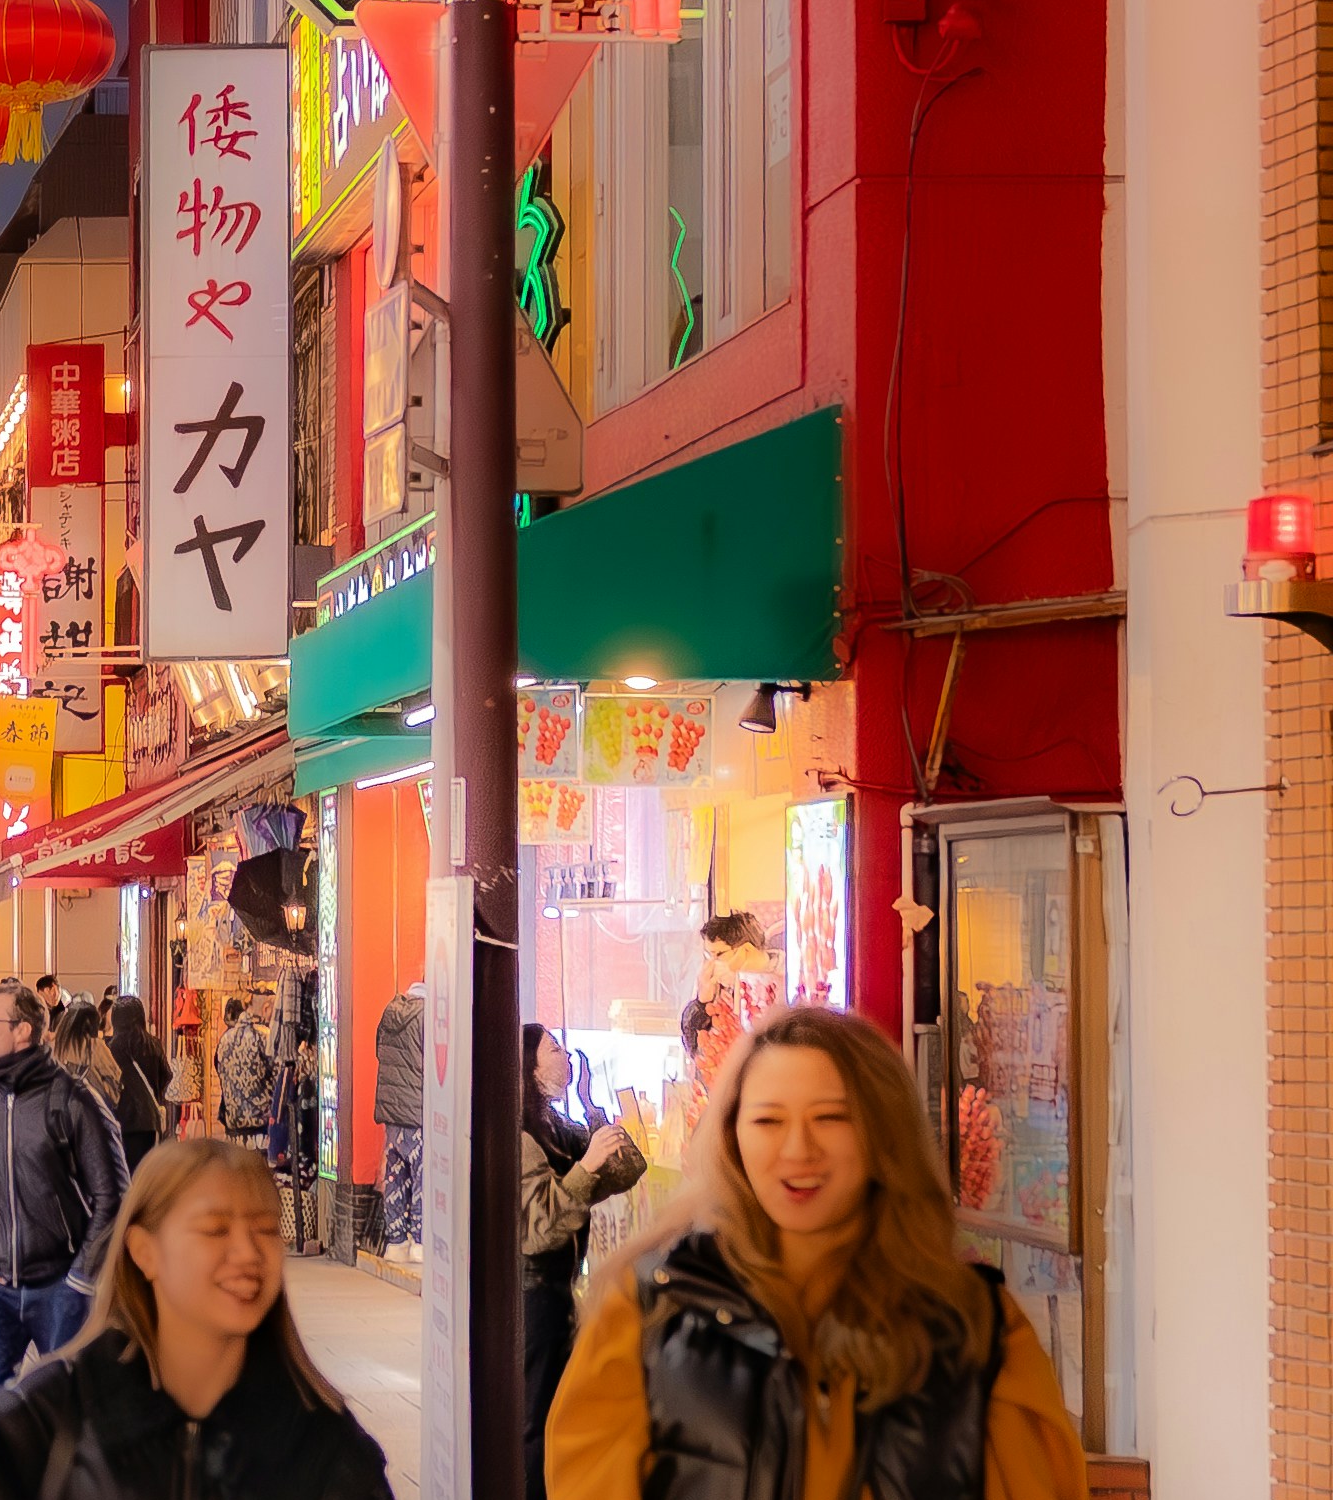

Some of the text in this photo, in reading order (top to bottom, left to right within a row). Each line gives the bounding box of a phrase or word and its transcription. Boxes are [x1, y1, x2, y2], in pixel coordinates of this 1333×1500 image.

[173, 84, 267, 613] 倭物や カヤ
[50, 360, 81, 478] 中華粥店
[58, 490, 73, 551] シャテンキ
[0, 719, 50, 747] 春節
